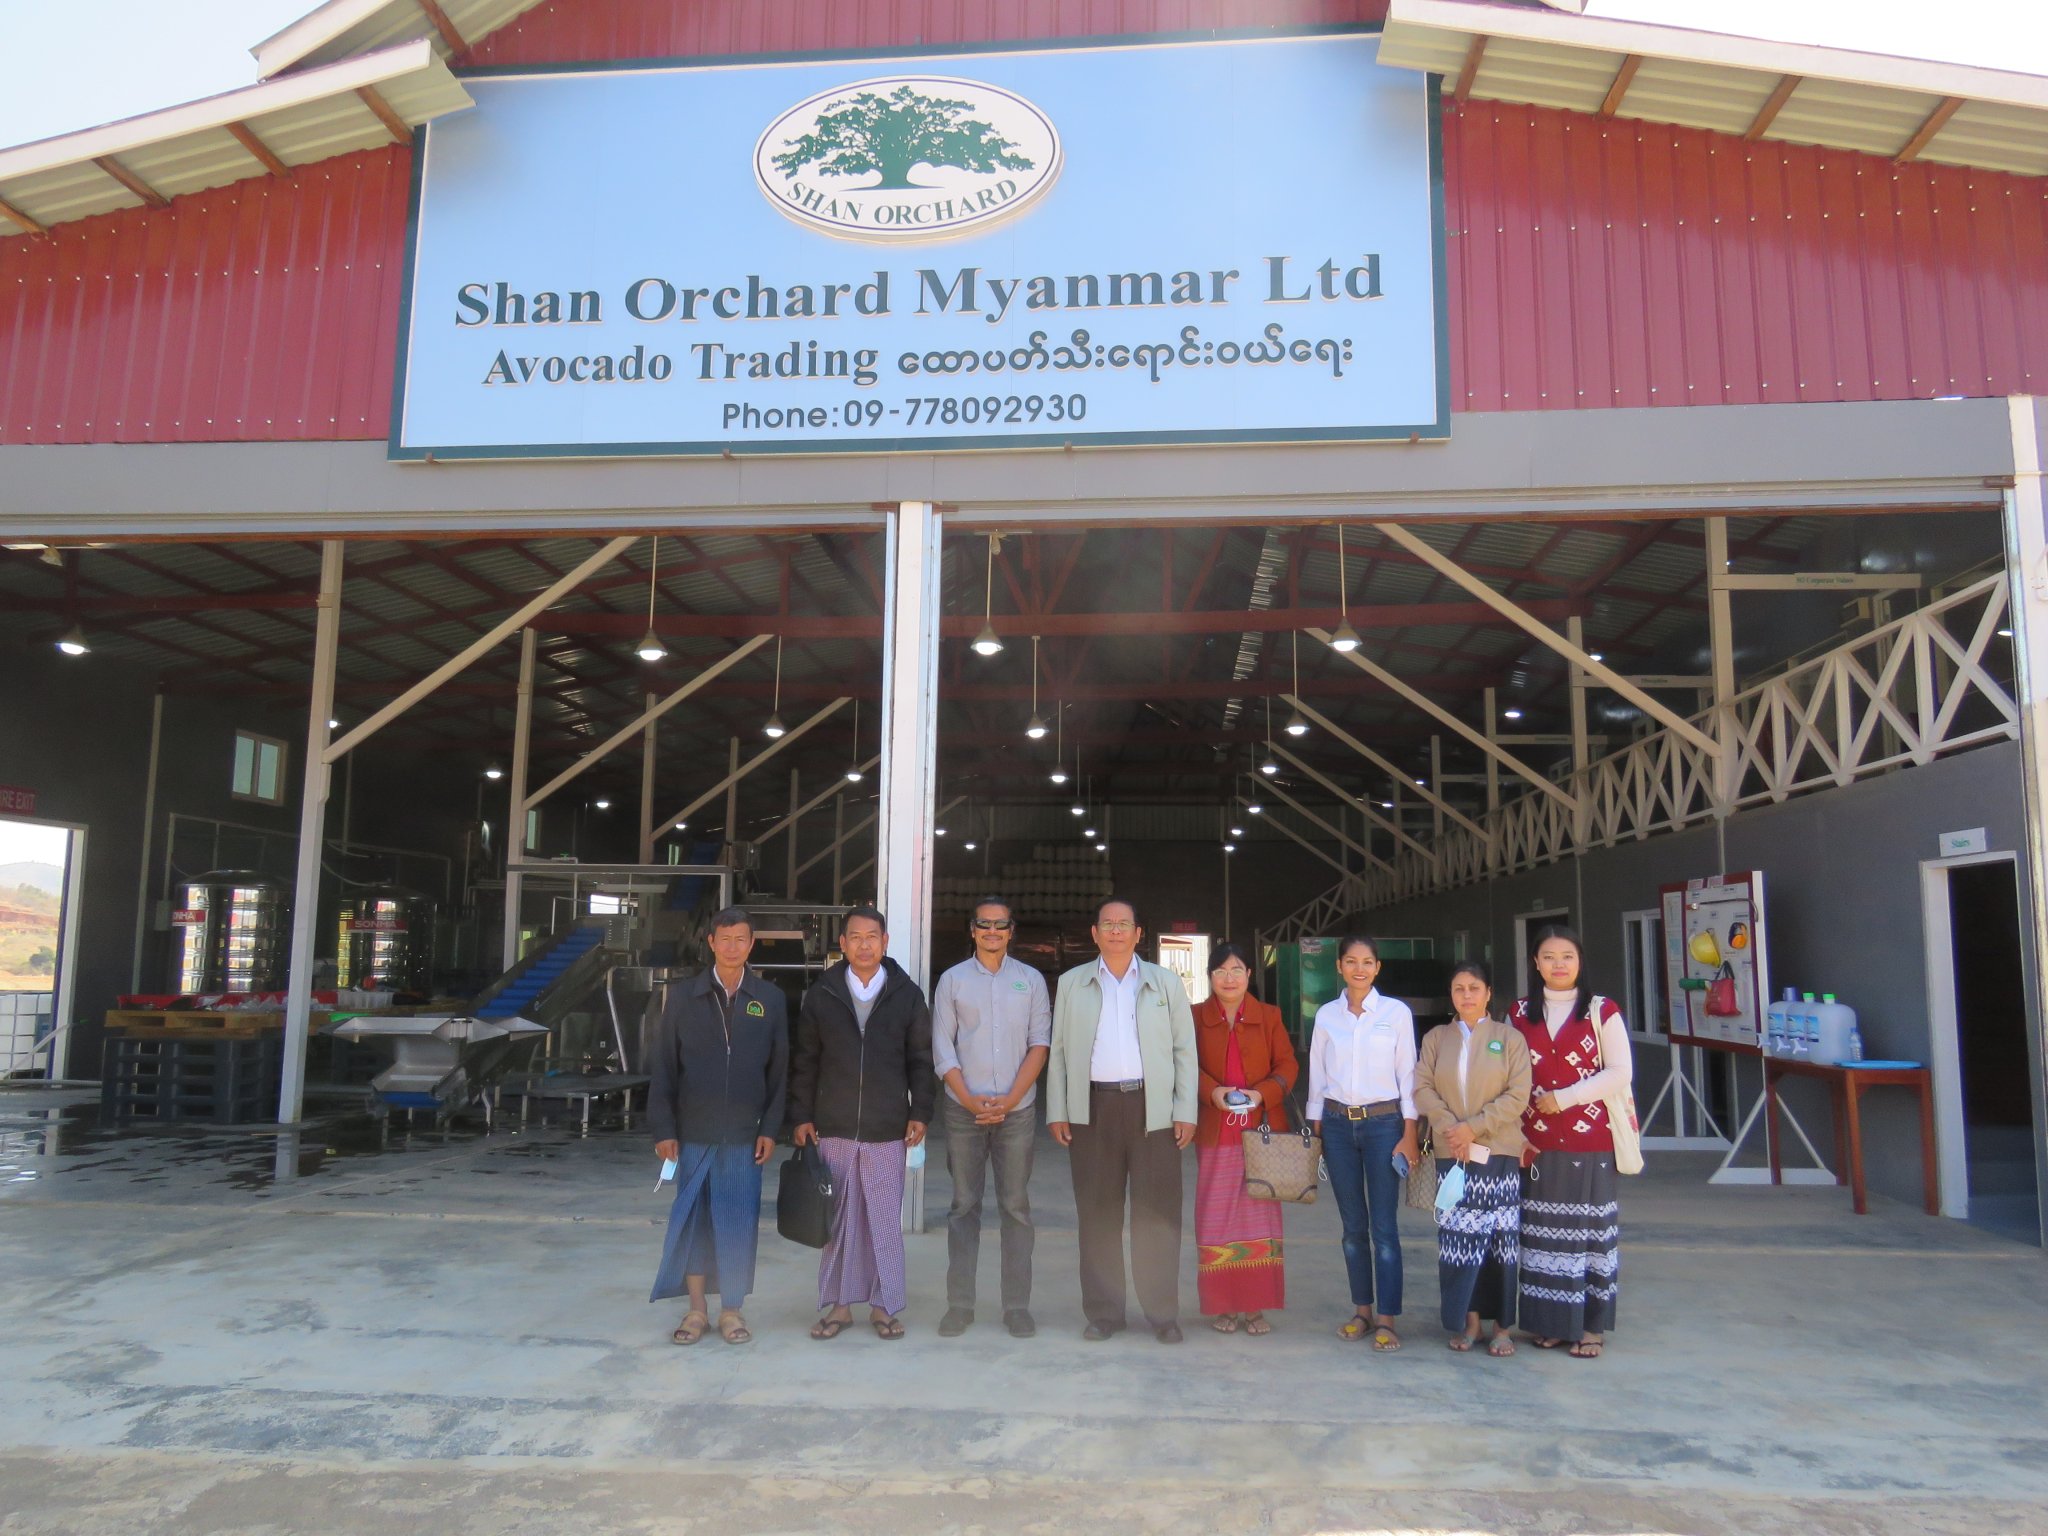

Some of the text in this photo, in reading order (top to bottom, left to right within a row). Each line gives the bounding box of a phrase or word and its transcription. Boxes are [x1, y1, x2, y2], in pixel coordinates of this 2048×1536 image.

[787, 179, 1017, 225] SHAN ORCHARD
[454, 253, 1385, 327] Shan Orchard Myanmar Ltd
[481, 339, 879, 387] Avocado Trading
[15, 791, 36, 810] EXIT
